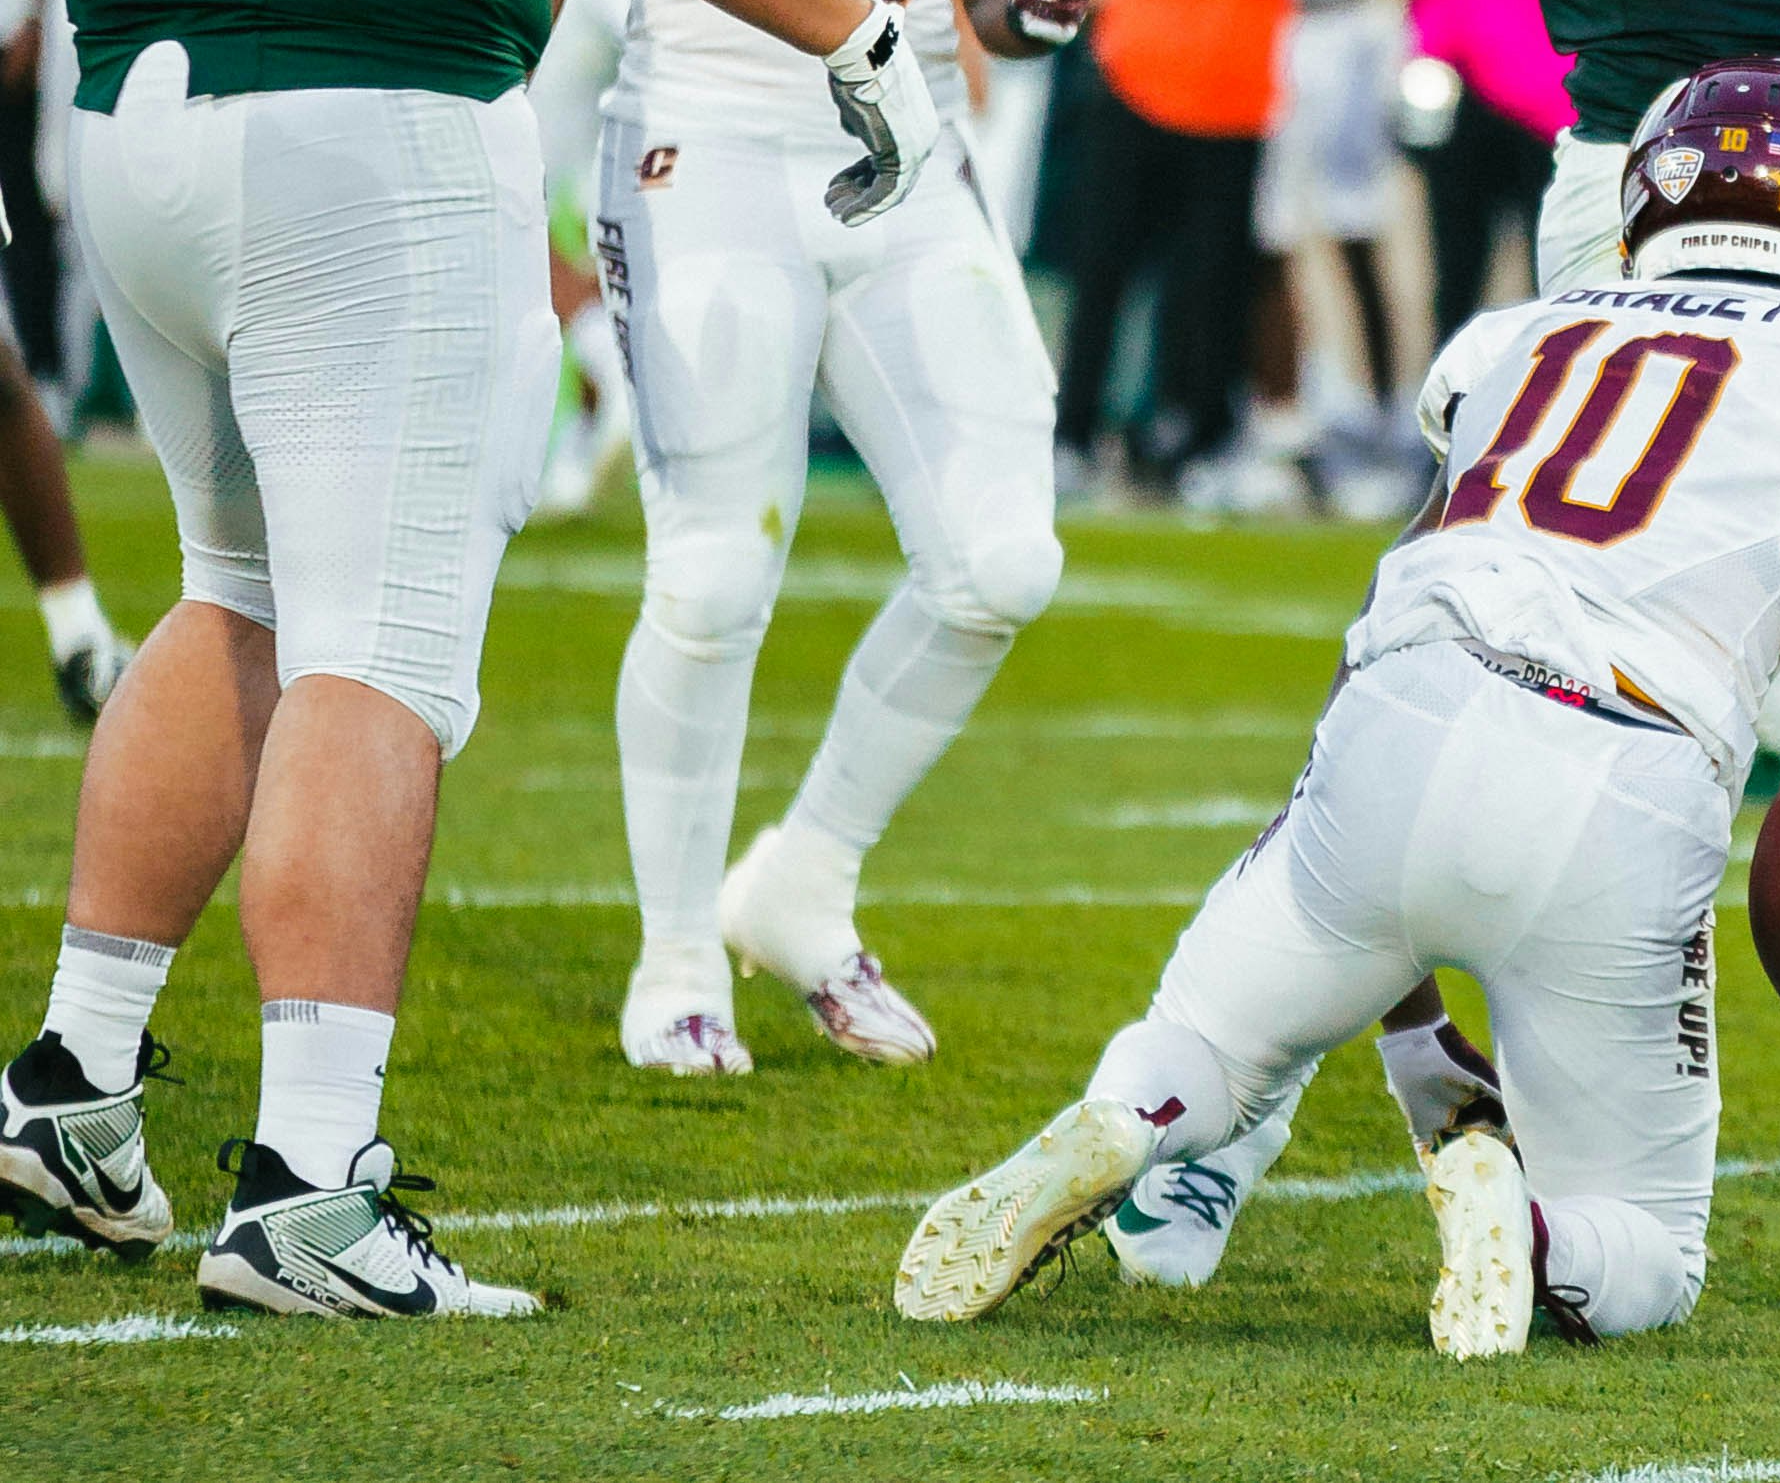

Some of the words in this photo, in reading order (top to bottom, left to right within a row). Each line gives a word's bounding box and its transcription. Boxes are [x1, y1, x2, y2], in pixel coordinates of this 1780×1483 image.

[1719, 128, 1749, 153] 10
[597, 216, 632, 309] FIRE
[1681, 234, 1708, 250] FIRE
[1711, 234, 1728, 247] UP
[1440, 319, 1743, 550] 10
[1677, 1001, 1710, 1079] UP!
[276, 1267, 356, 1317] FORCE
